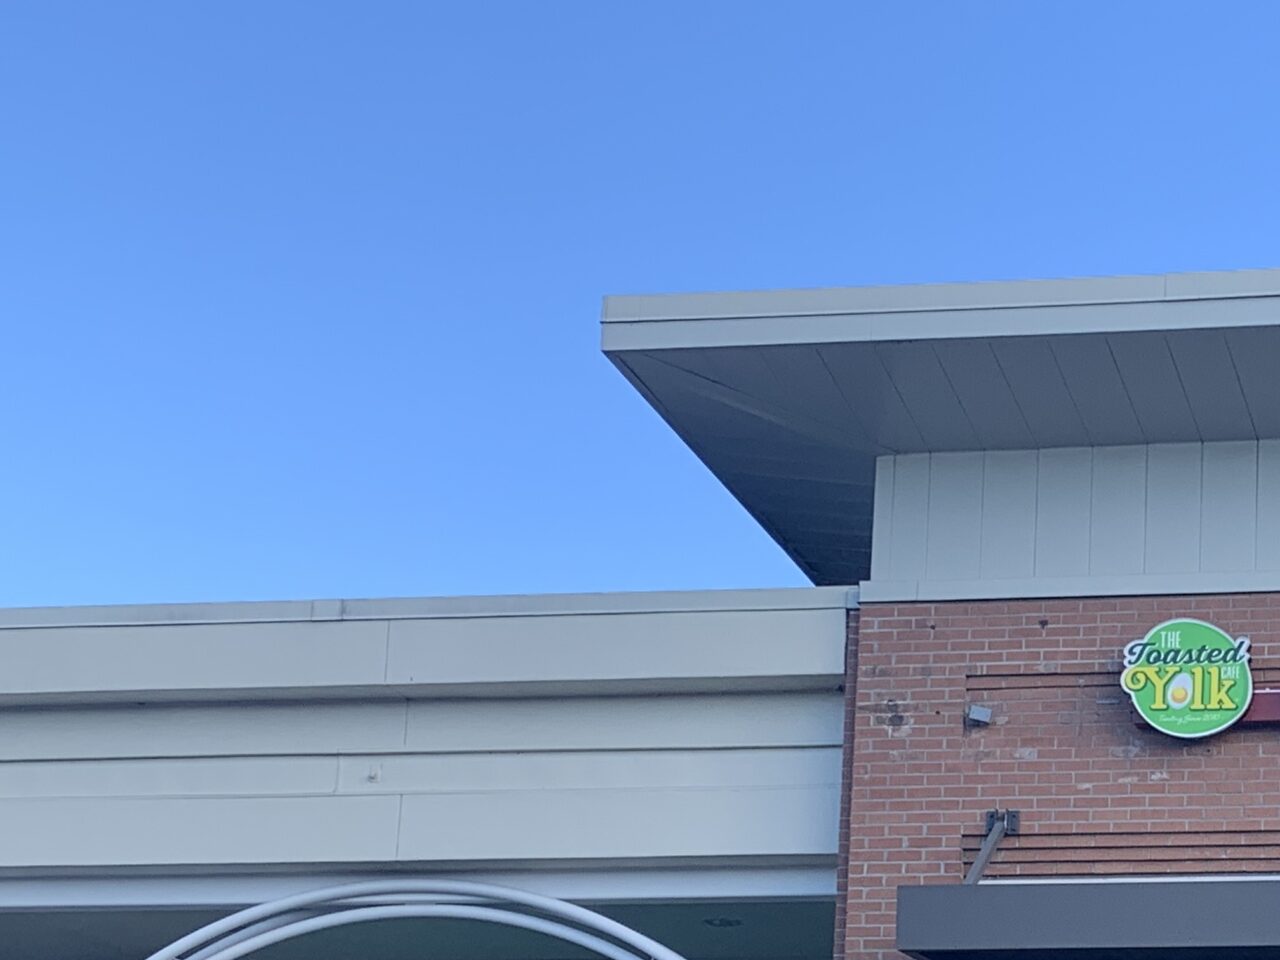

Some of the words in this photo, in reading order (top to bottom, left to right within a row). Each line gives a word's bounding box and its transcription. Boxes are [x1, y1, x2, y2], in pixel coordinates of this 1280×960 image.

[1160, 631, 1181, 648] THE
[1127, 640, 1246, 665] Toasted
[1125, 666, 1238, 711] Yolk
